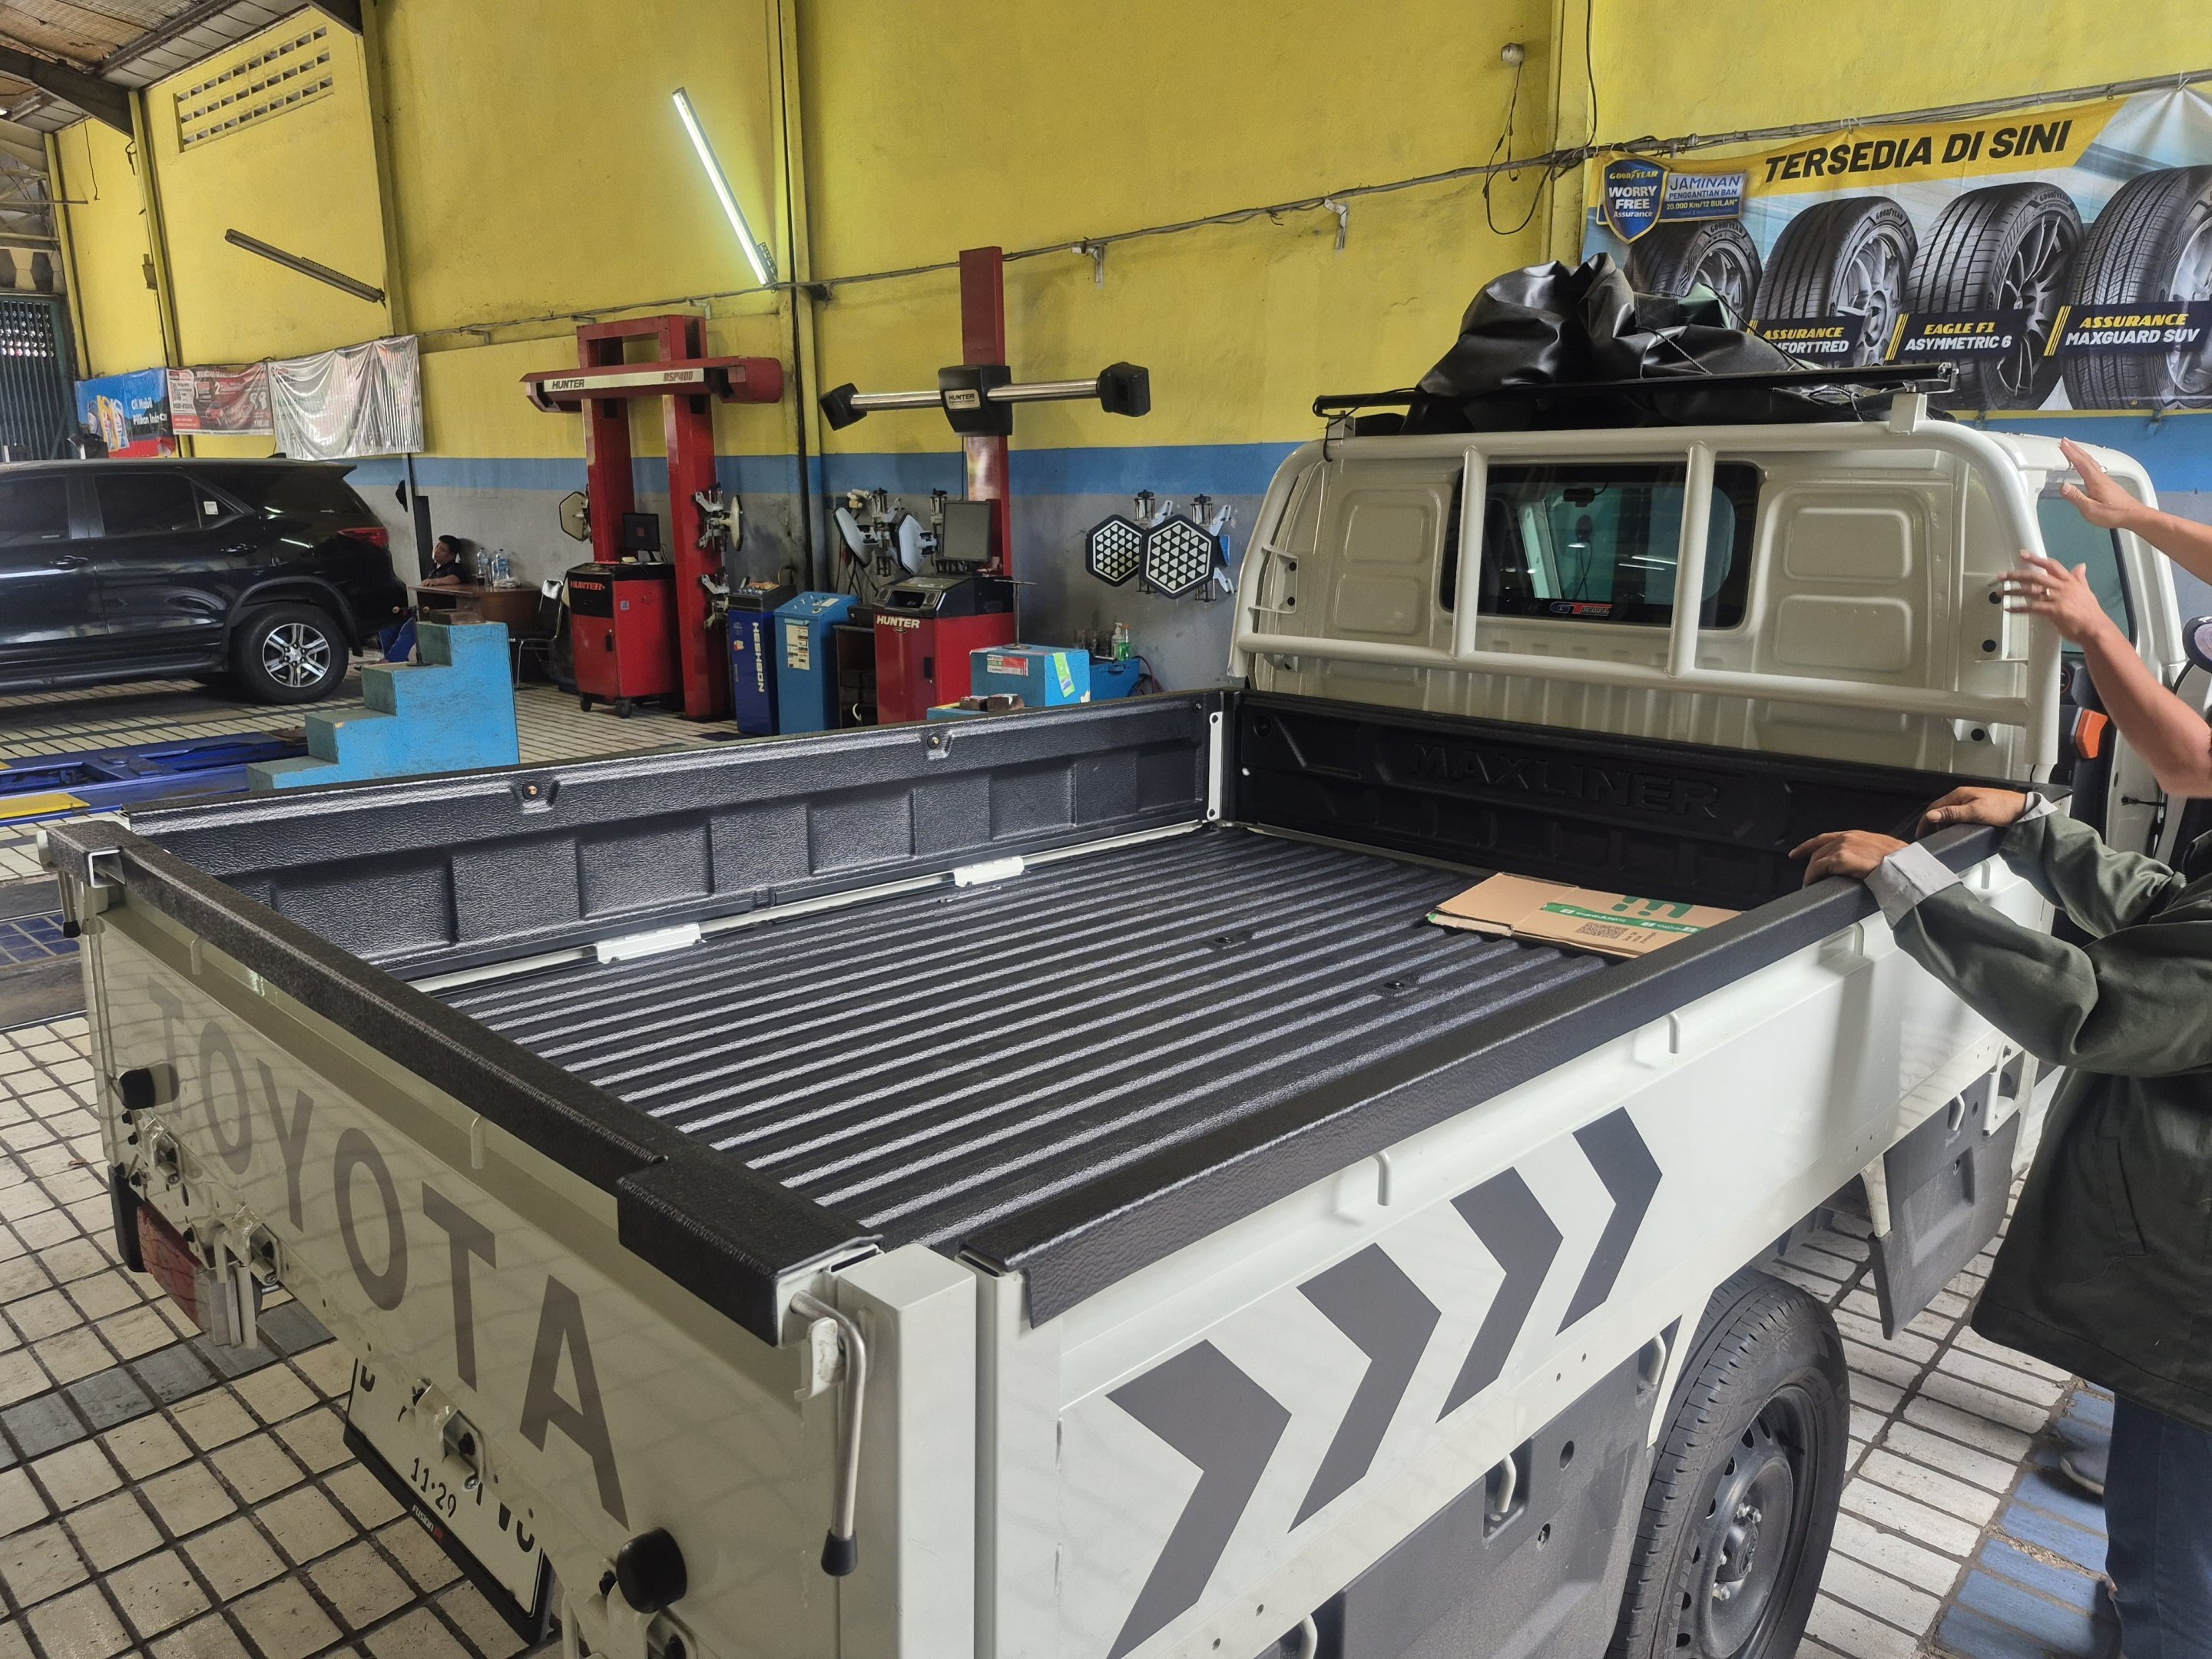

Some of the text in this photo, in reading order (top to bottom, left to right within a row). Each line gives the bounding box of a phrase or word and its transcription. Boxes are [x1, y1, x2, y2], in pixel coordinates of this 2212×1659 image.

[1764, 120, 2073, 183] TERSEDIA DI SINI
[1609, 170, 1658, 180] GOODYEAR
[1670, 175, 1740, 191] JAMINAN
[1608, 185, 1657, 197] WORRY
[1668, 190, 1720, 200] PENGGANTIAN
[1615, 199, 1651, 210] FREE
[1666, 202, 1688, 210] 20.000
[1689, 200, 1710, 209] Km/12
[2079, 313, 2189, 328] ASSURANCE
[1763, 327, 1845, 340] ASSURANCE
[1923, 322, 1995, 335] EAGLE F1
[1904, 335, 2013, 351] ASYMMETRIC 6
[2065, 328, 2201, 346] MAXGUARD SUV
[551, 379, 584, 389] HUNTER
[570, 581, 602, 591] HUNTER
[876, 614, 921, 629] HUNTER
[752, 622, 765, 693] HESHBON
[1411, 743, 1719, 819] MAXLINER
[148, 975, 630, 1532] TOYOTA
